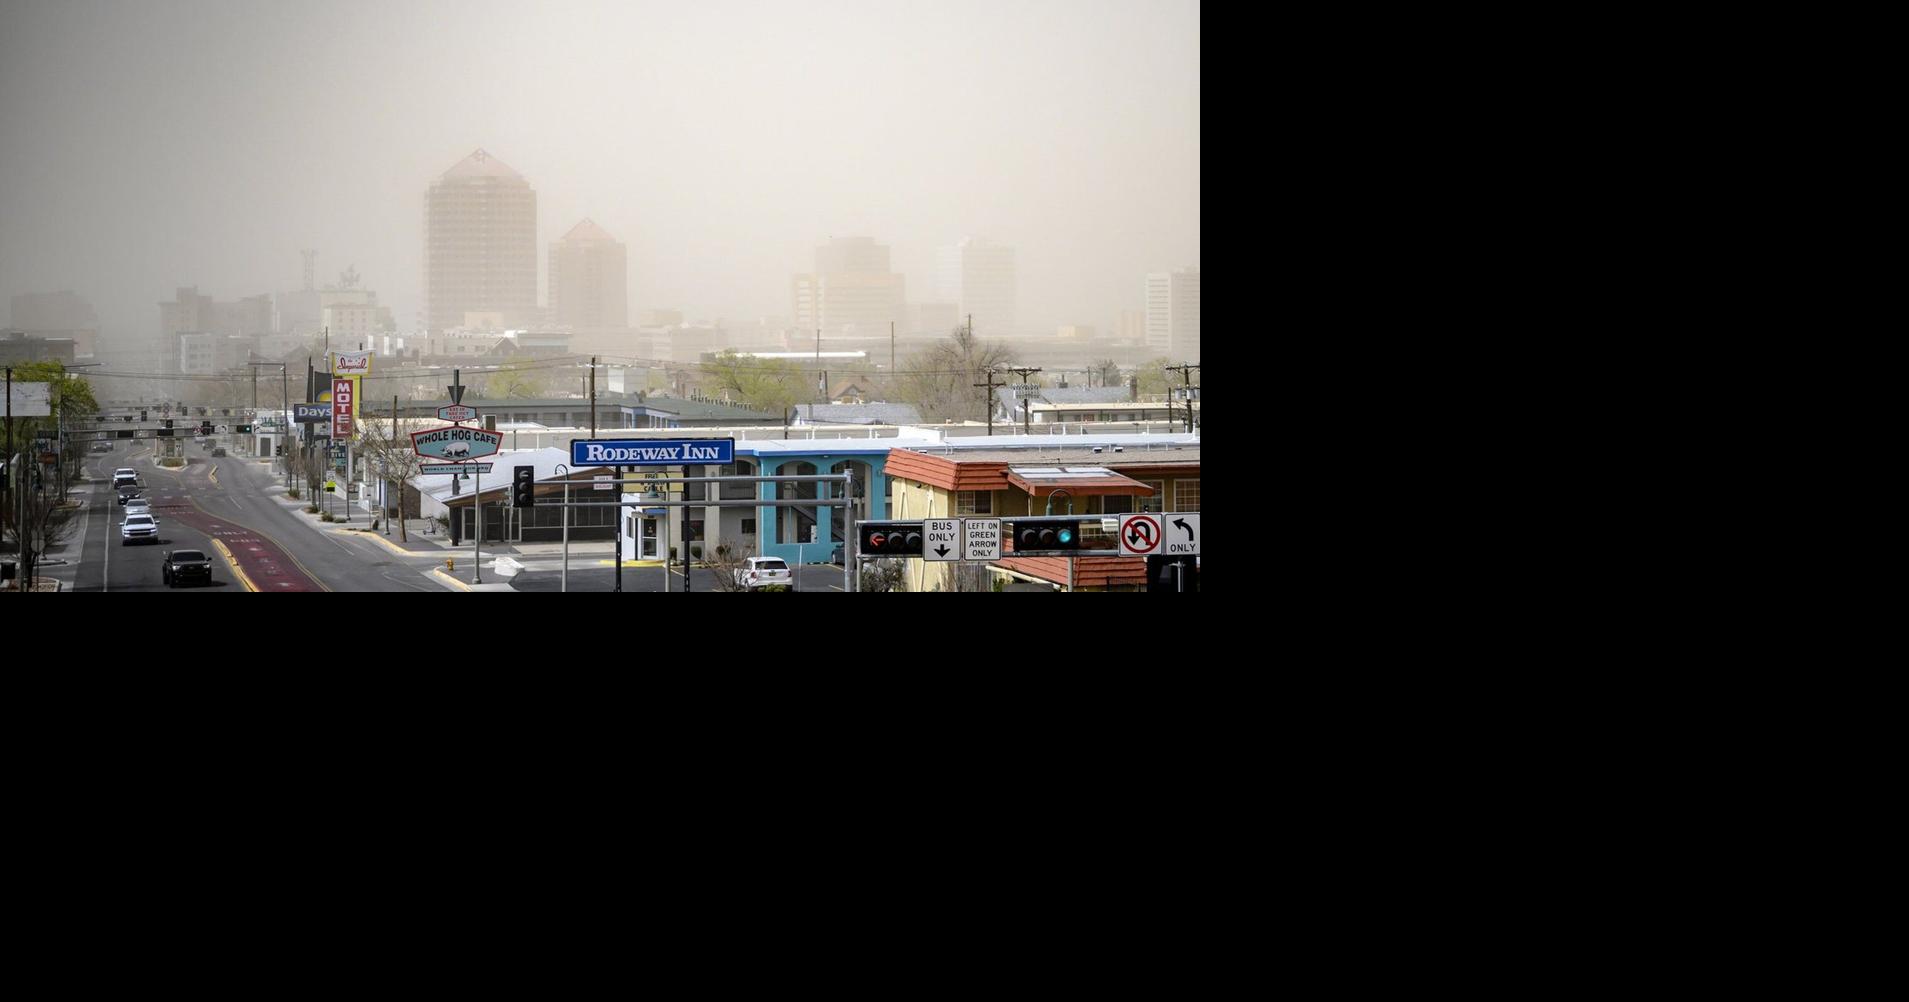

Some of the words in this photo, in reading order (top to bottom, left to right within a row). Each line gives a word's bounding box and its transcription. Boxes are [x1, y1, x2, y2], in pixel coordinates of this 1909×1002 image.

[298, 406, 331, 417] Days
[336, 382, 350, 434] MOTEL
[416, 430, 449, 446] WHOLE
[451, 429, 471, 441] HOG
[473, 431, 497, 445] CAFE
[586, 444, 680, 461] RODEWAY
[682, 443, 720, 459] INN
[932, 521, 953, 531] BUS
[967, 522, 985, 530] LEFT
[988, 522, 998, 530] ON
[928, 533, 956, 541] ONLY
[970, 531, 996, 539] GREEN
[969, 540, 997, 548] ARROW
[1170, 543, 1196, 552] ONLY
[972, 549, 993, 557] ONLY
